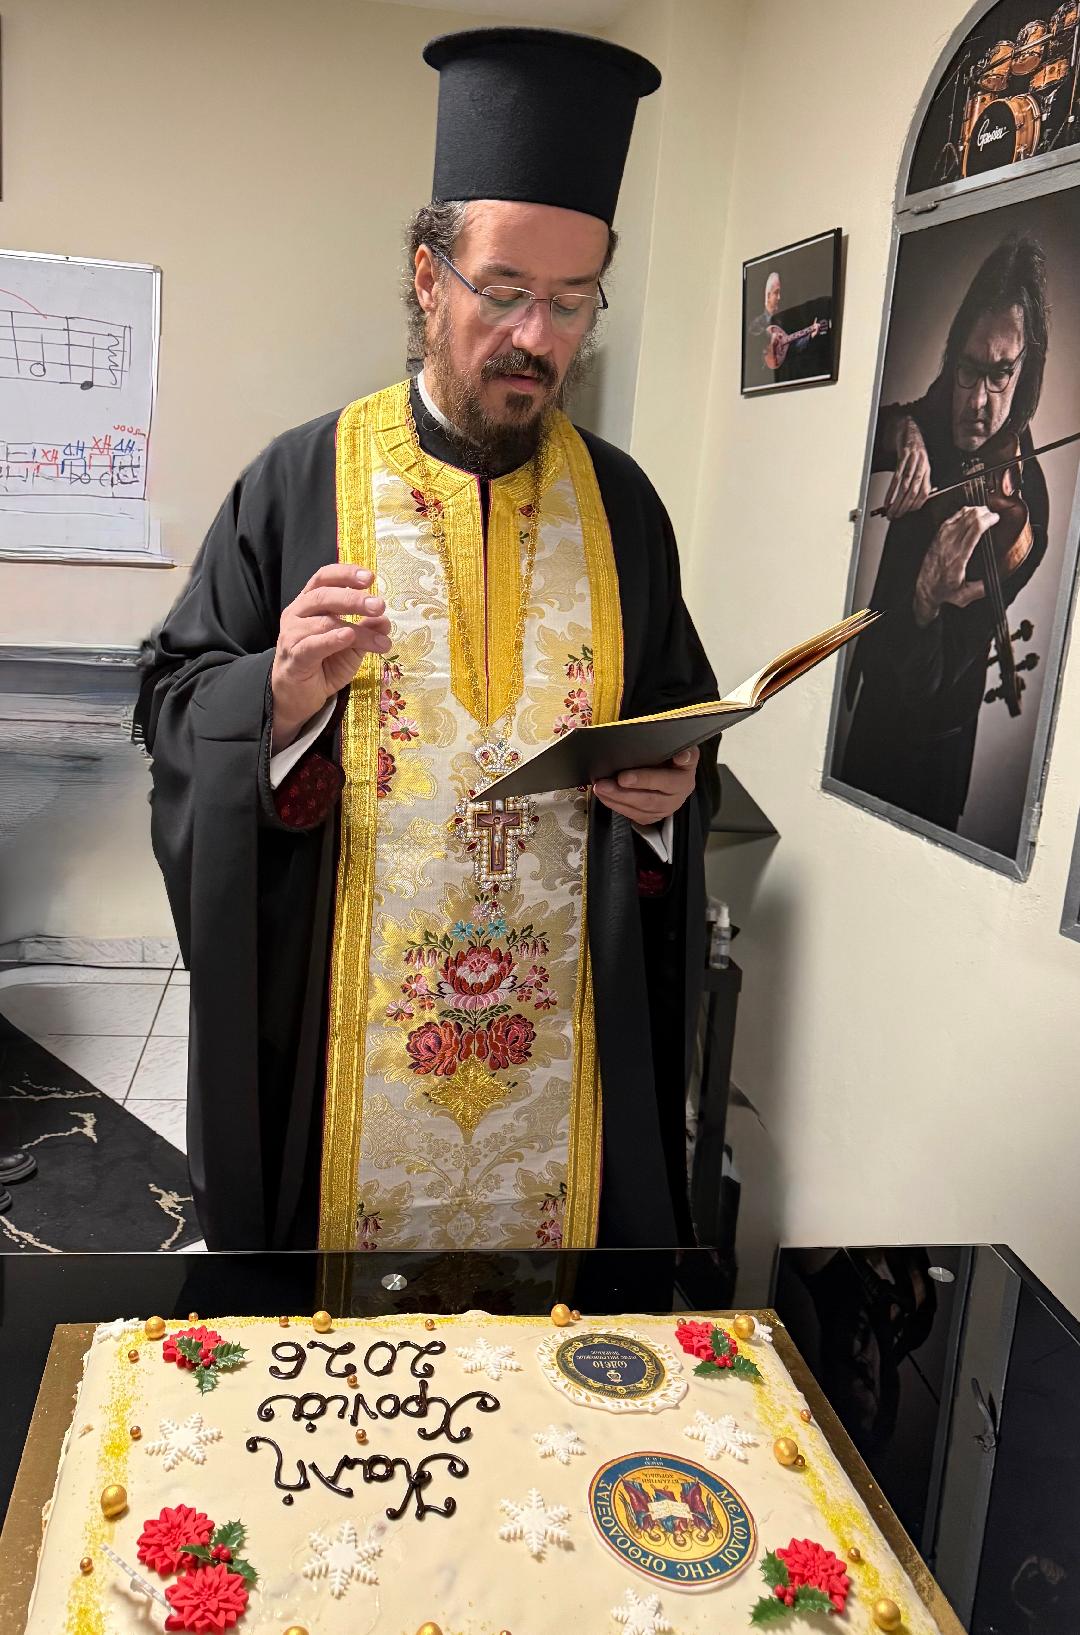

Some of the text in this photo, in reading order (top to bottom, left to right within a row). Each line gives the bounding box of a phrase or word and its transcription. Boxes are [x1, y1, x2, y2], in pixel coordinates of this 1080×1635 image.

[269, 1340, 446, 1379] 2026
[257, 1379, 501, 1443] Χρονιά
[246, 1436, 469, 1521] Καλή
